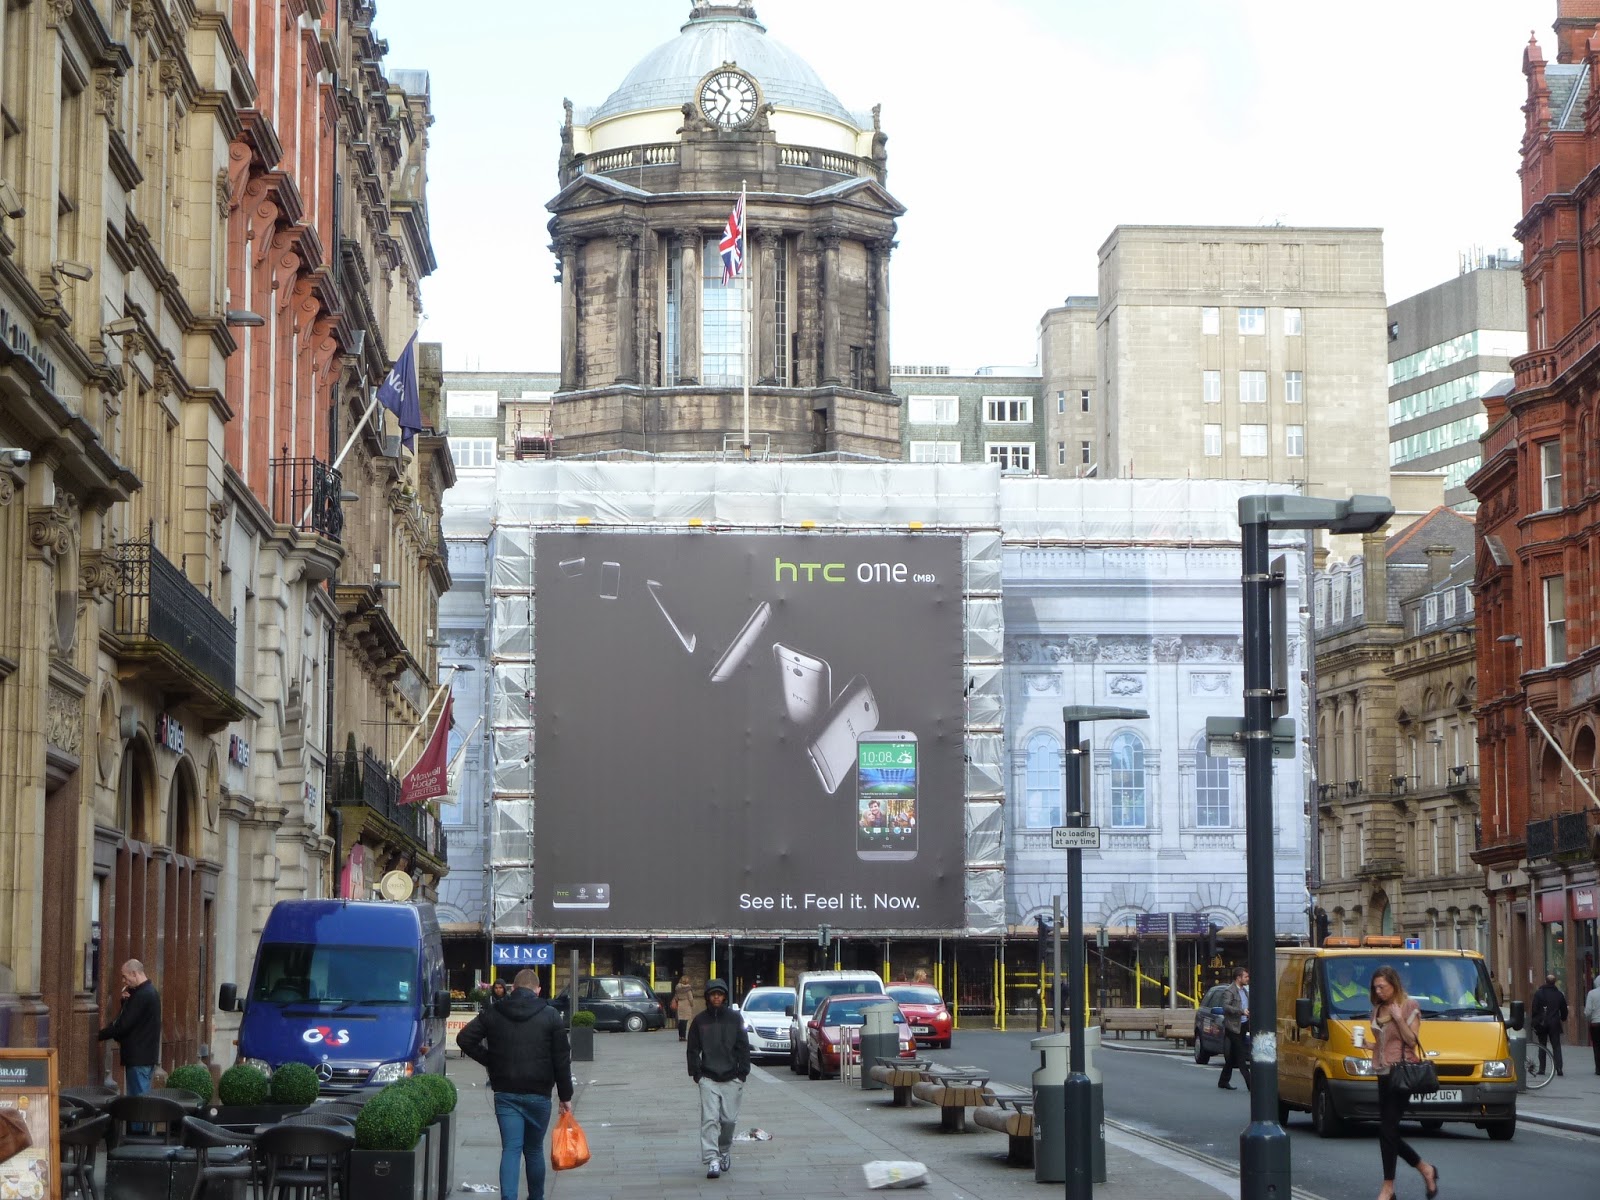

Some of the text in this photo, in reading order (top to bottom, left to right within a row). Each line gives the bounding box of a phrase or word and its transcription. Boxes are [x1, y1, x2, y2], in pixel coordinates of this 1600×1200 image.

[912, 573, 936, 583] (M8)
[862, 751, 893, 763] 10:08
[410, 766, 441, 782] Maxwell
[1069, 830, 1096, 838] loading
[739, 893, 920, 909] See it. Feel it. Now.
[499, 946, 548, 959] KING
[302, 1026, 350, 1046] G4S
[1440, 1091, 1458, 1100] UGY
